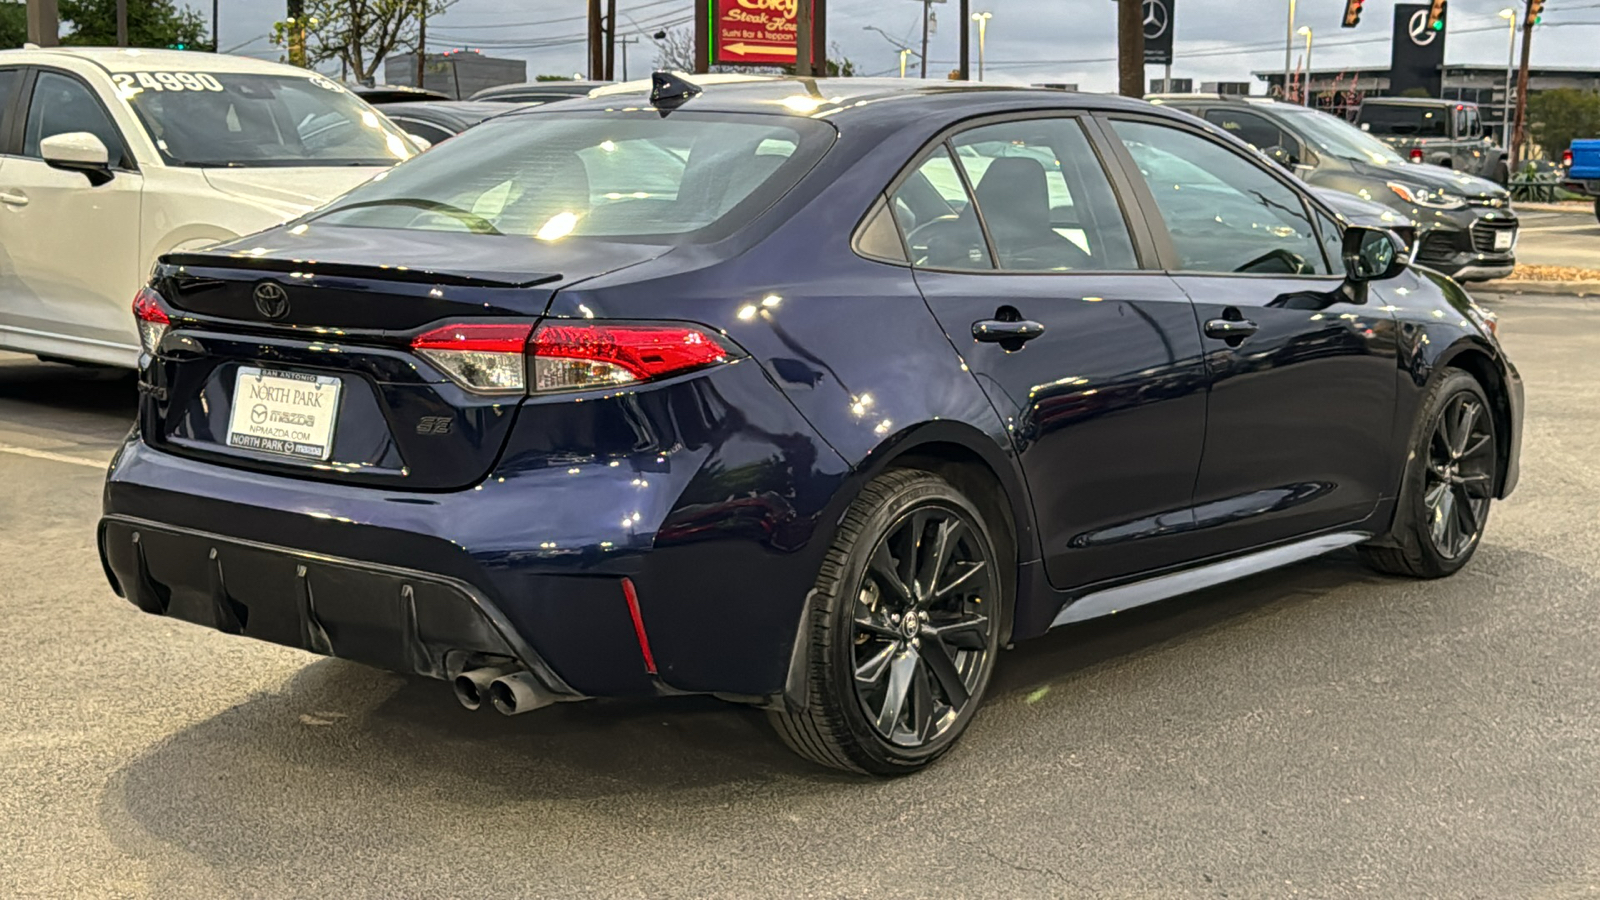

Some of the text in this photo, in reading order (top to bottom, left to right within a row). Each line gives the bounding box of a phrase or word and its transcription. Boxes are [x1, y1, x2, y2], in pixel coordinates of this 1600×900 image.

[721, 9, 797, 31] Steak Hou
[722, 28, 741, 37] Sushi
[742, 30, 755, 39] Bar
[765, 31, 794, 40] Teppan
[111, 72, 224, 92] 24990
[280, 371, 316, 382] ANTONIO
[250, 383, 324, 408] NORTH PARK
[269, 410, 316, 428] mazda
[249, 424, 311, 441] NPMAZDA.COM
[231, 434, 261, 448] NORTH
[261, 439, 283, 452] PARK
